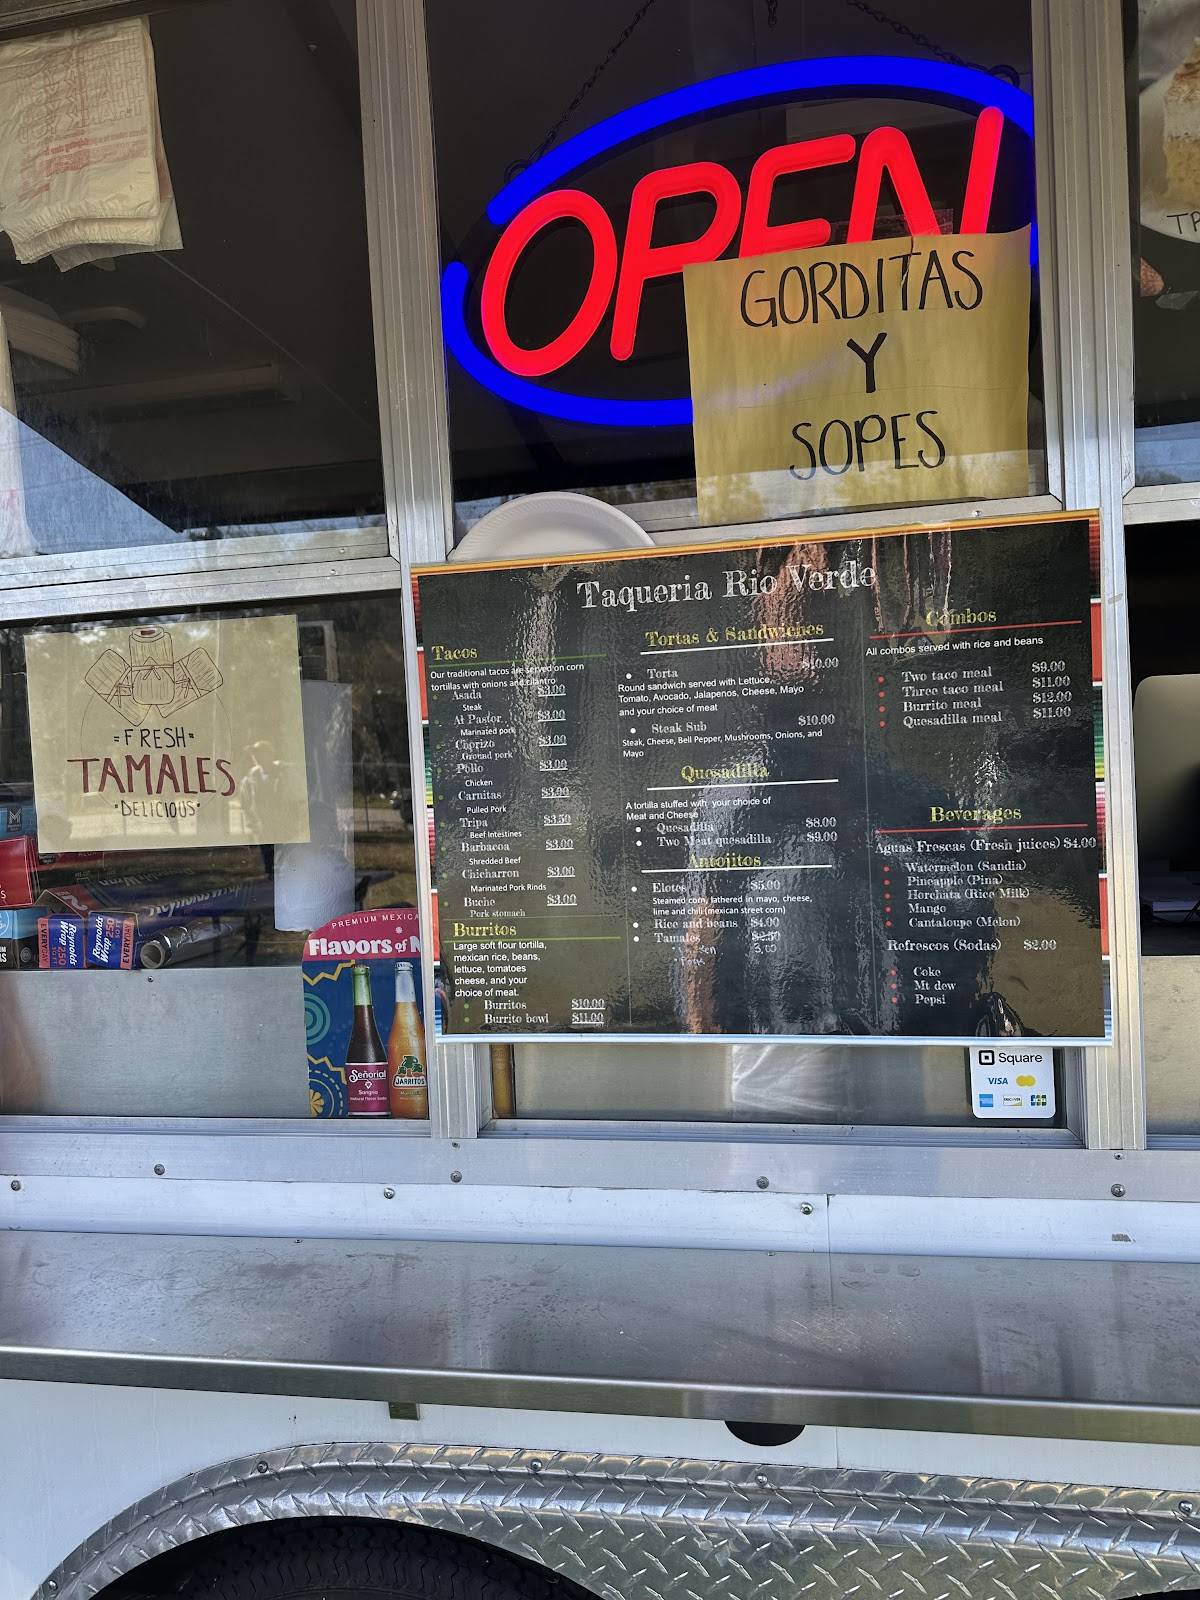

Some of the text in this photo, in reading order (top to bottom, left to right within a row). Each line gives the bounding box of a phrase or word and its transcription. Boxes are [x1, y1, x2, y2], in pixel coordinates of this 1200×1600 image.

[481, 106, 1005, 377] OPEN
[740, 249, 983, 328] GORDITAS
[846, 333, 888, 394] Y
[789, 410, 946, 480] SOPES
[577, 561, 877, 613] Taqueria Rio Verde
[926, 608, 997, 626] Combos
[645, 622, 824, 647] Tortas & Sandwiches
[865, 636, 1043, 656] All combos served with rice and beans
[431, 646, 478, 660] Tacos
[1032, 661, 1066, 673] $9.00
[647, 669, 678, 679] Torta
[902, 667, 992, 683] Two taco meal
[618, 684, 645, 692] Round
[648, 682, 686, 690] sandwich
[689, 679, 716, 688] served
[719, 678, 736, 686] with
[1032, 676, 1071, 688] $11.00
[452, 690, 482, 700] Asada
[618, 686, 804, 703] Tomato, Avocado, Jalapenos, Cheese, Mayo
[902, 681, 1004, 698] Three taco meal
[1033, 691, 1072, 704] $12.00
[463, 703, 482, 711] Steak
[619, 708, 635, 716] and
[637, 709, 655, 717] your
[657, 706, 685, 714] choice
[697, 704, 717, 712] meat
[903, 698, 982, 712] Burrito meal
[1033, 707, 1071, 719] $11.00
[799, 714, 835, 726] $10.00
[903, 712, 1002, 727] Quesadilla meal
[461, 728, 498, 736] Marinated
[652, 721, 707, 734] Steak Sub
[622, 739, 645, 747] Steak,
[647, 738, 676, 746] Cheese,
[678, 736, 697, 744] Bell
[699, 735, 723, 744] Pepper,
[725, 732, 773, 742] Mushrooms,
[775, 731, 805, 739] Onions,
[623, 750, 644, 758] Mayo
[456, 763, 483, 773] Pollo
[681, 762, 769, 783] Quesadilla
[67, 754, 236, 796] TAMALES
[458, 791, 501, 800] Carnitas
[627, 811, 698, 820] Meat and Cheese
[930, 806, 1022, 824] Beverages
[460, 817, 488, 828] Tripa
[806, 817, 836, 828] $8.00
[807, 832, 838, 842] $9.00
[462, 842, 509, 852] Barbacoa
[875, 837, 1097, 856] Aguas Frescas (Fresh juices) $4.00
[905, 861, 1027, 873] Watermelon (Sandia)
[462, 869, 520, 879] Chicharron
[907, 875, 1003, 887] Pineapple (Pina)
[908, 888, 1030, 900] Horchata (Rice Milk)
[464, 898, 495, 907] Buche
[470, 909, 525, 918] Pork stomach
[909, 903, 946, 915] Mango
[332, 916, 377, 928] PREMIUM
[909, 916, 1020, 929] Cantaloupe (Melon)
[454, 922, 516, 937] Burritos
[58, 920, 69, 966] Wrap 250
[92, 916, 104, 958] Reynolds
[100, 918, 114, 962] Wrap 250
[67, 923, 78, 965] Reynolds
[122, 924, 132, 964] EVERYDAY
[309, 939, 392, 955] Flavors
[394, 939, 409, 953] of
[454, 941, 547, 951] Large soft flour tortilla,
[888, 939, 1056, 951] Refrescos (Sodas) $2.00
[454, 953, 540, 962] mexican rice, beans,
[455, 964, 526, 974] lettuce, tomatoes
[913, 967, 941, 977] Coke
[455, 977, 488, 985] cheese,
[508, 977, 528, 986] your
[914, 981, 956, 991] Mt dew
[455, 989, 482, 997] choice
[495, 989, 519, 997] meat.
[485, 1000, 526, 1010] Burritos
[915, 994, 946, 1007] Pepsi
[485, 1014, 548, 1024] Burrito bowl
[999, 1053, 1042, 1065] Square
[349, 1070, 386, 1082] Señorial
